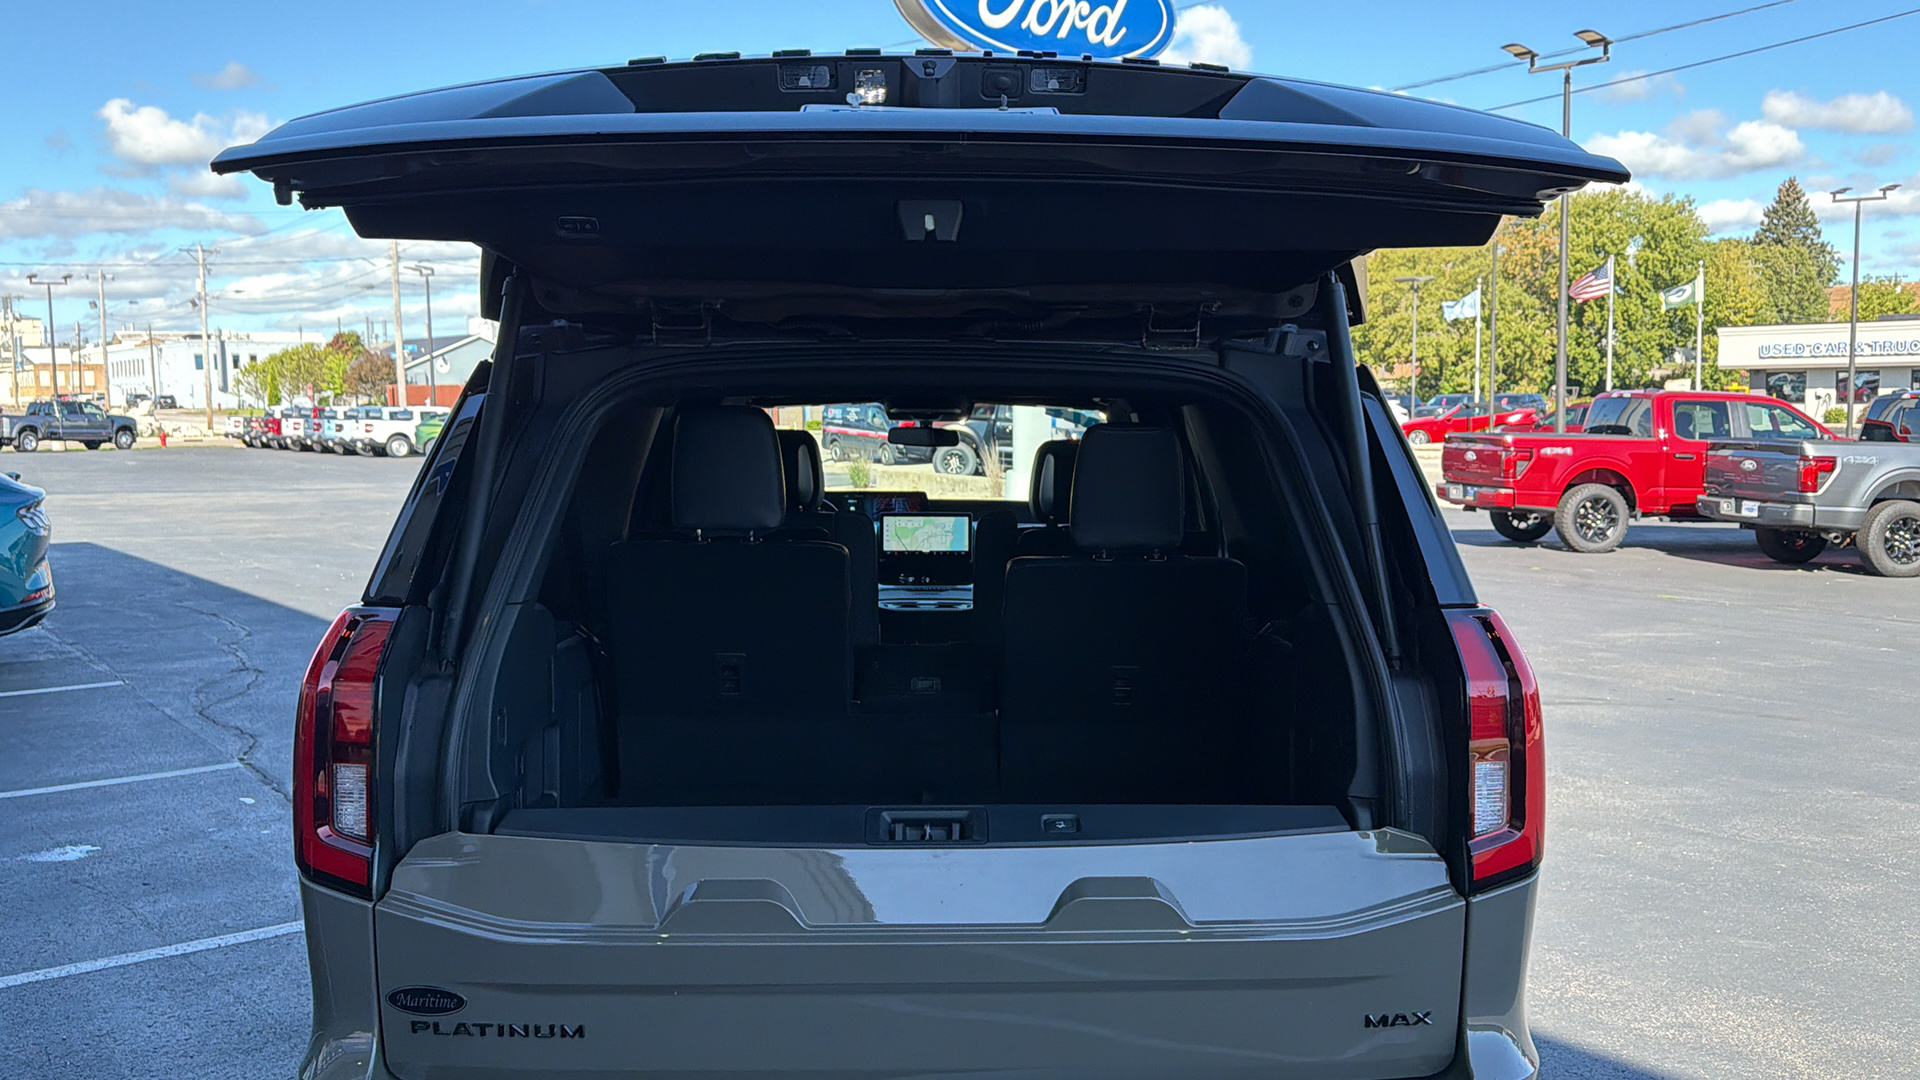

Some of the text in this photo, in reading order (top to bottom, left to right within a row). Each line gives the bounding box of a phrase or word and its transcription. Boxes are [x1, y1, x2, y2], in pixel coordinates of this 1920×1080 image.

[1760, 343, 1805, 356] USED
[1812, 342, 1848, 354] CAR
[396, 993, 458, 1009] Maritime
[1364, 1010, 1433, 1028] MAX
[410, 1020, 586, 1039] PLATINUM
